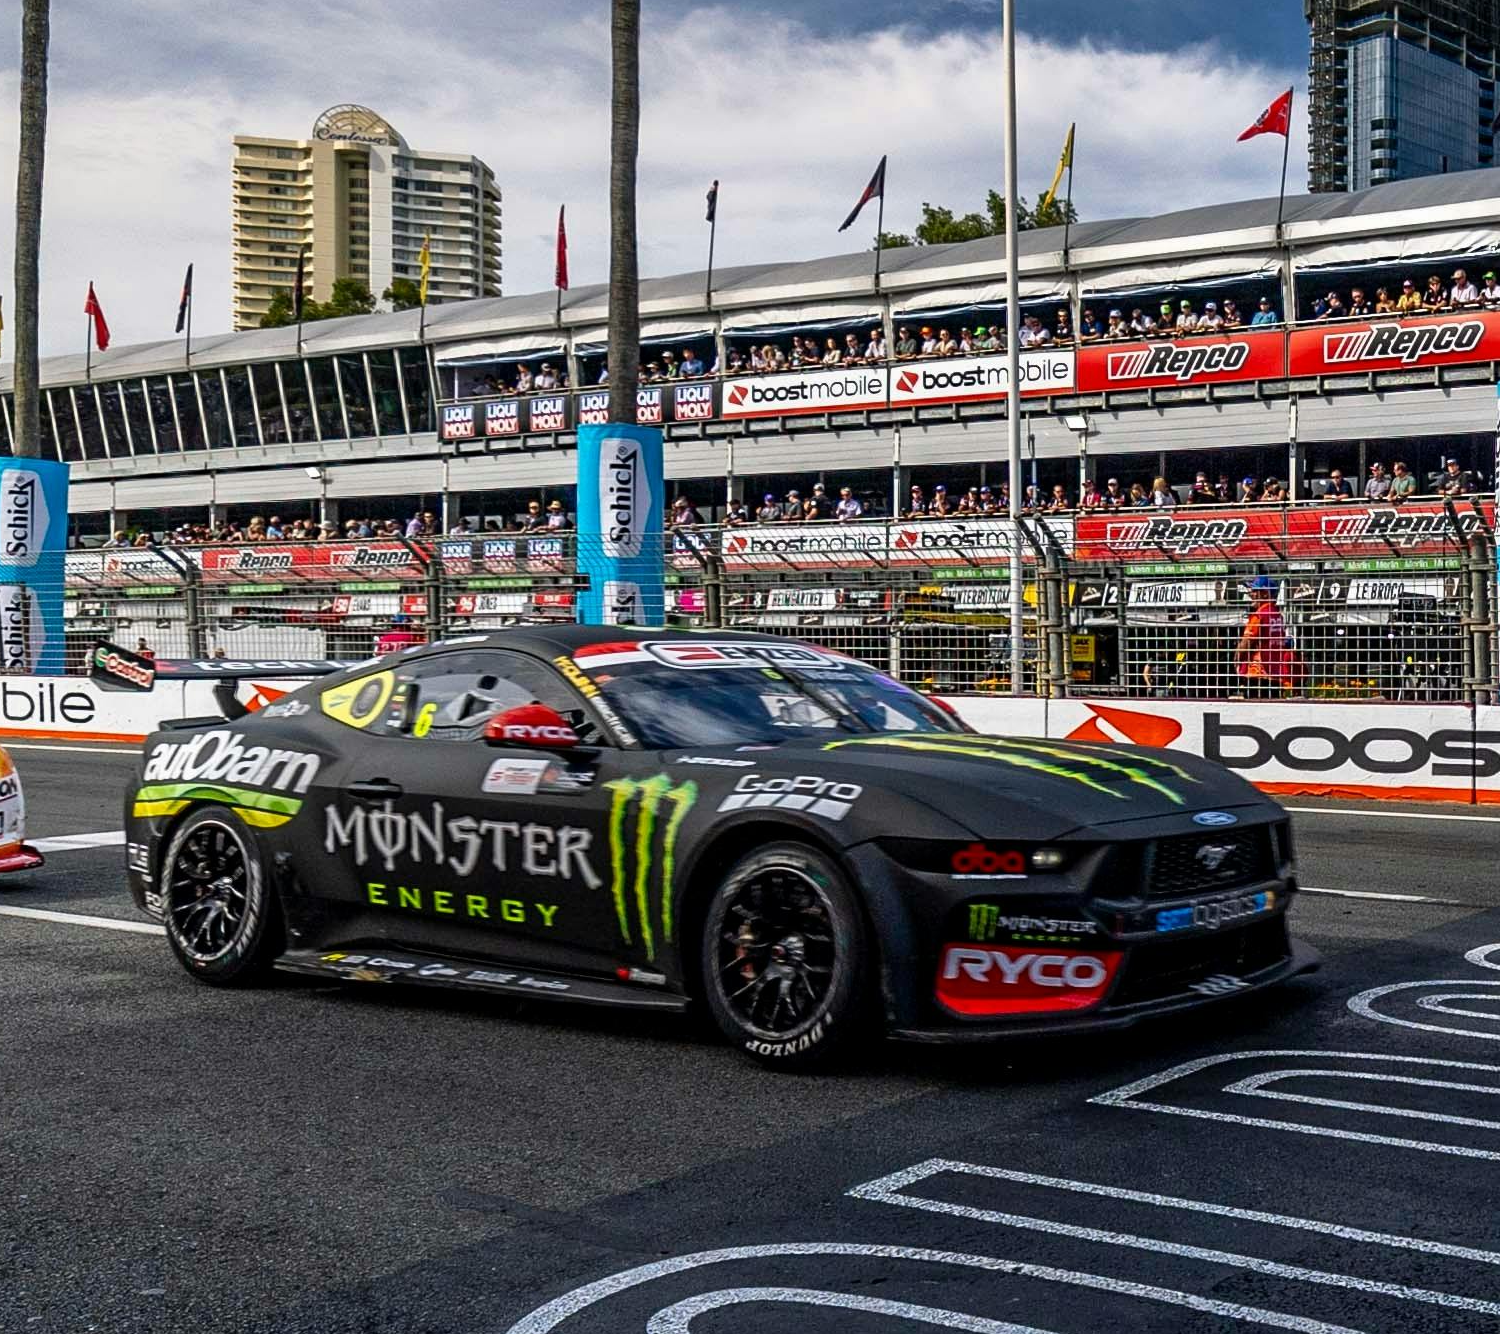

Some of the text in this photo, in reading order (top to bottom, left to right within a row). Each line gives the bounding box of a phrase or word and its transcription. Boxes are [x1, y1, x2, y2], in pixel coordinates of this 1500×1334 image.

[1365, 320, 1485, 362] Repco
[1142, 342, 1250, 379] Repco
[636, 391, 660, 407] QUI
[676, 387, 710, 403] LIQUI
[751, 377, 883, 404] boostmobile
[531, 400, 564, 415] LIQUI
[581, 394, 610, 410] LIQU
[444, 409, 473, 423] LIQUI
[487, 404, 517, 419] LIQUI
[636, 406, 661, 422] OLY
[675, 403, 712, 419] MOLY
[443, 422, 474, 438] MOLY
[486, 418, 518, 434] MOLY
[531, 415, 564, 430] MOLY
[609, 447, 637, 546] Schick
[5, 477, 36, 558] Schick
[1136, 586, 1183, 603] REYNOLDS
[1329, 582, 1341, 600] 9
[1355, 583, 1369, 600] LE
[193, 660, 300, 672] tech
[412, 703, 438, 739] 6
[733, 773, 864, 801] GoPro
[324, 798, 604, 890] MONSTER
[367, 881, 560, 928] ENERGY
[942, 946, 1108, 990] RYCO
[744, 1021, 825, 1058] DUNLOP
